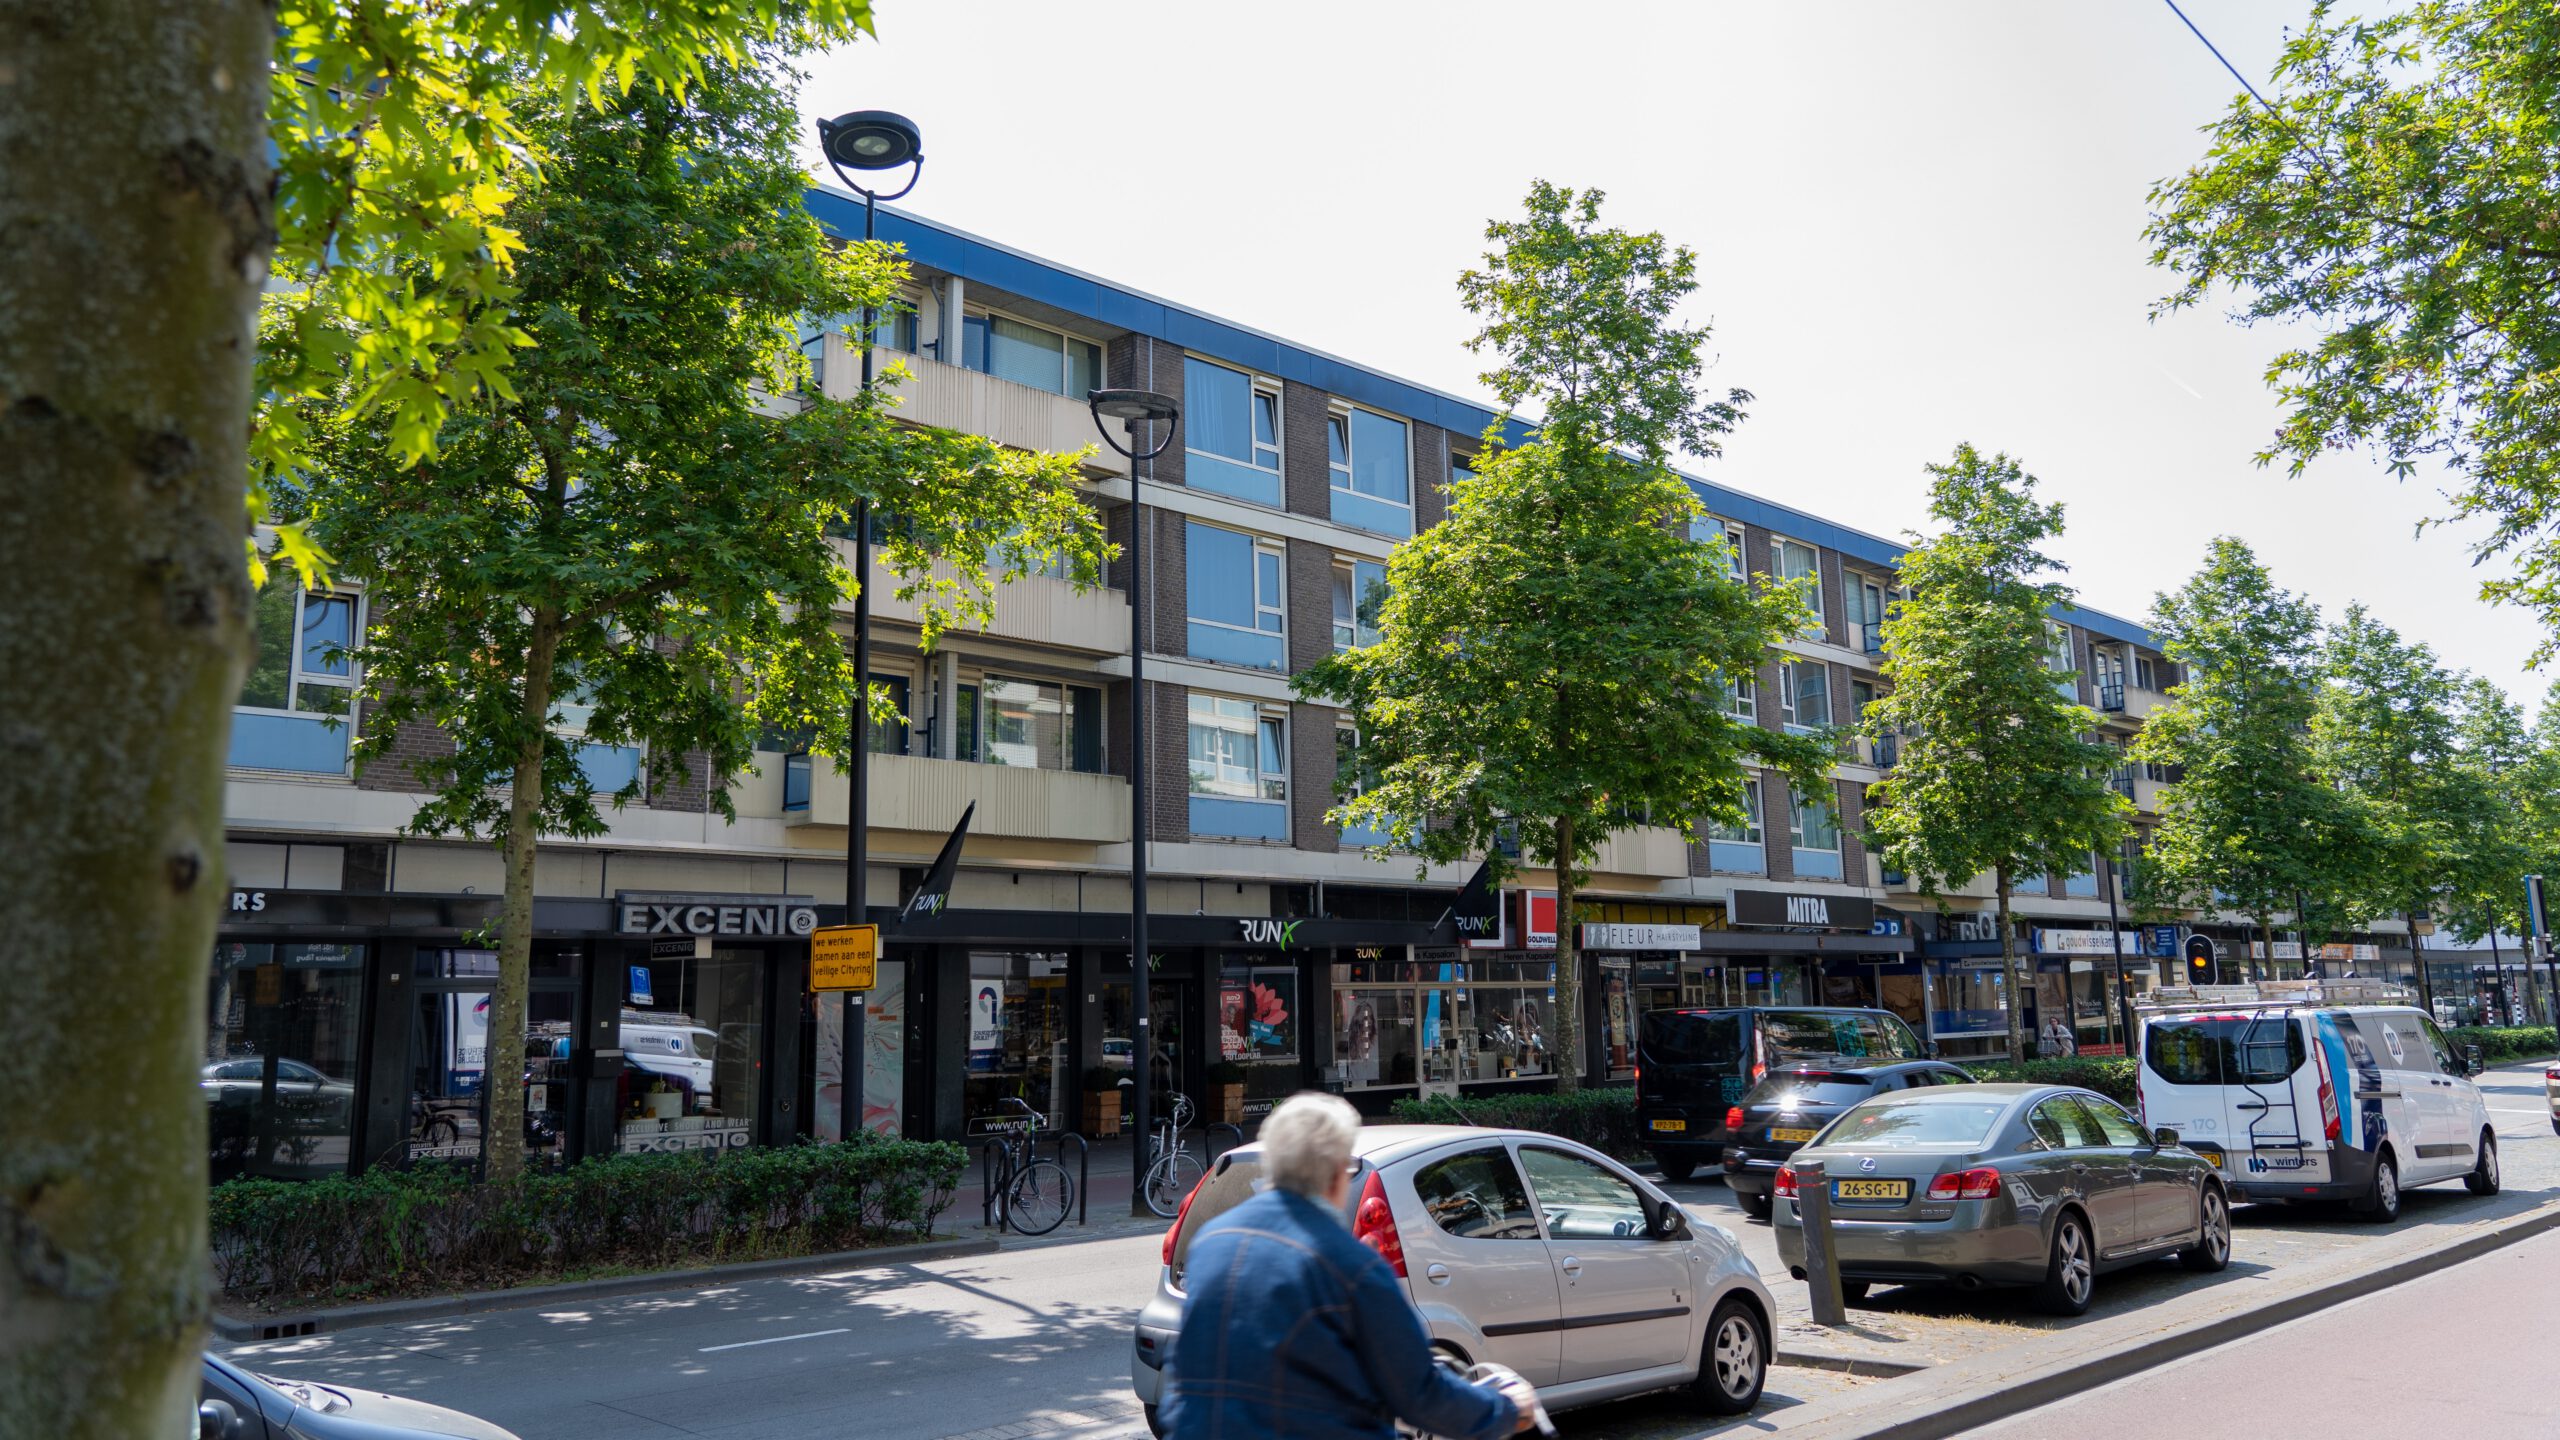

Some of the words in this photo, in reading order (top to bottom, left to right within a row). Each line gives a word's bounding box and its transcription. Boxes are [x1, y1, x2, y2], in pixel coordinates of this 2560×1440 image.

[232, 893, 266, 911] RS
[915, 893, 948, 916] RUNX
[1787, 897, 1829, 924] MITRA
[1455, 915, 1497, 935] RUNX
[815, 939, 826, 947] we
[828, 936, 854, 947] werken
[1239, 920, 1304, 952] RUNX
[1611, 929, 1654, 944] FLEUR
[2066, 934, 2125, 950] goudwisselkantr
[815, 953, 839, 961] samen
[841, 952, 855, 960] aan
[857, 951, 871, 959] een
[1355, 947, 1384, 960] RUNX
[1423, 951, 1456, 960] Kapsalon
[815, 965, 839, 978] veilige
[841, 964, 871, 976] Cityring
[626, 1123, 669, 1135] EXCLUSIVE
[705, 1119, 721, 1129] AND
[2192, 1119, 2217, 1130] 170
[1844, 1183, 1901, 1196] 26-SG-TJ
